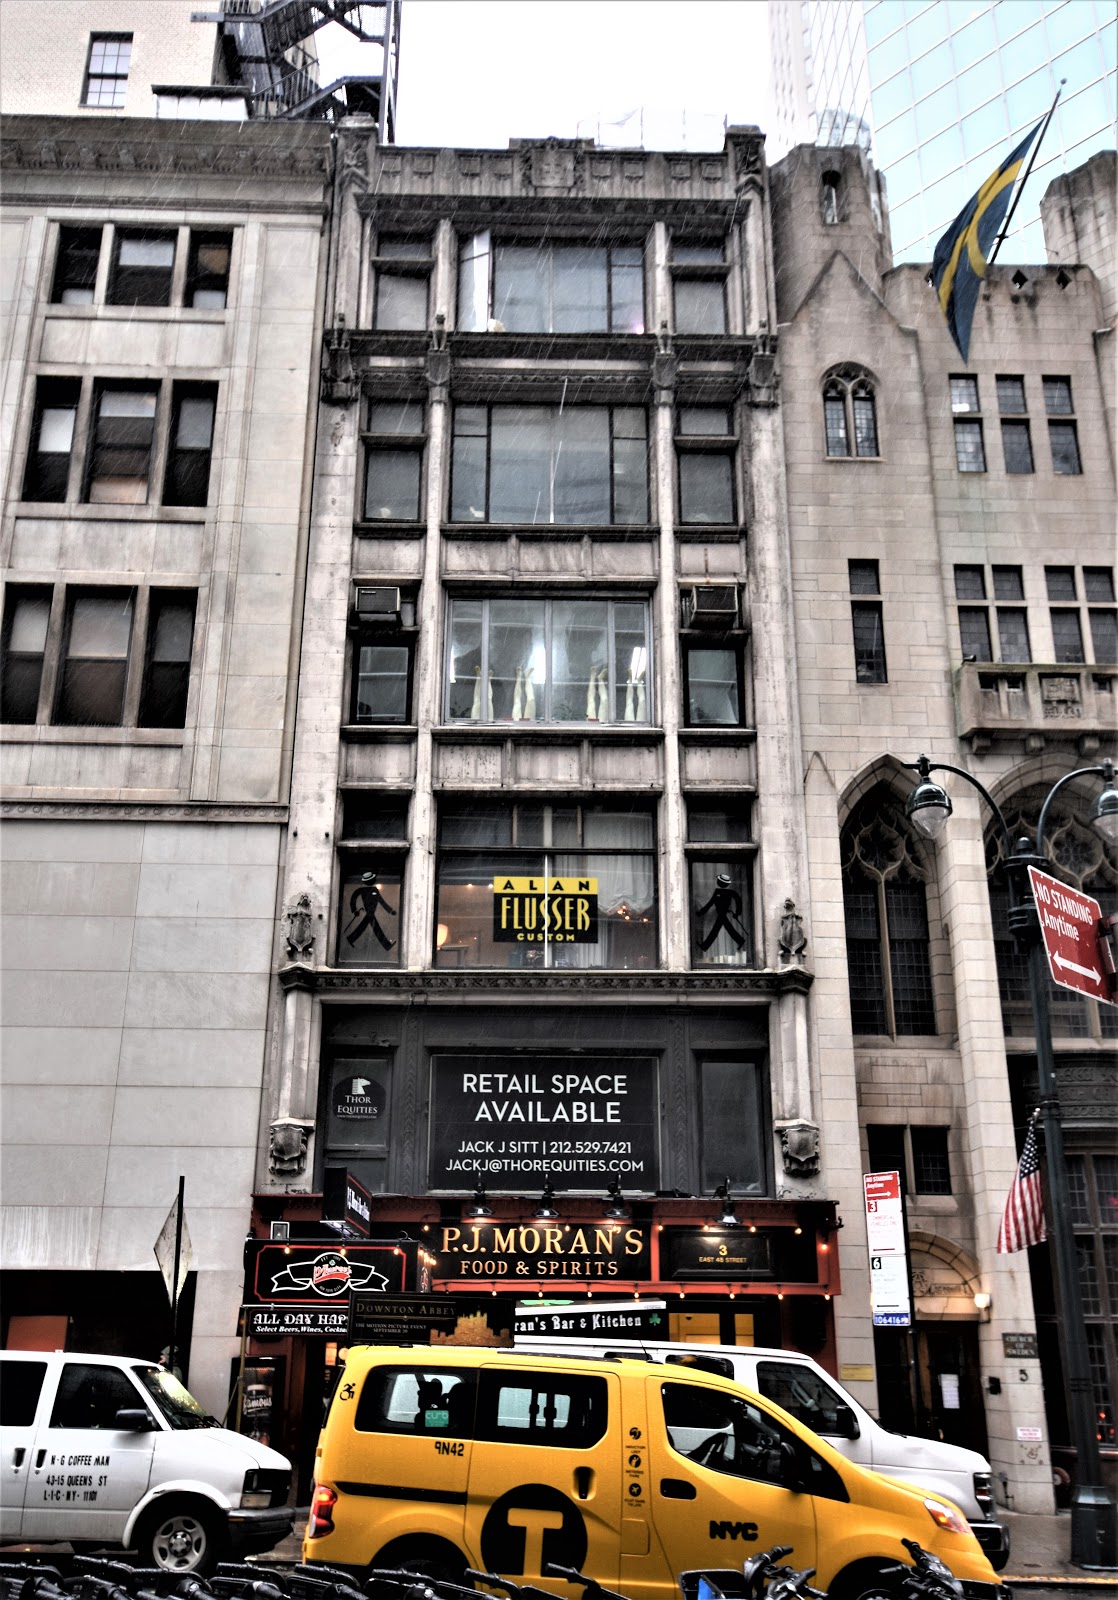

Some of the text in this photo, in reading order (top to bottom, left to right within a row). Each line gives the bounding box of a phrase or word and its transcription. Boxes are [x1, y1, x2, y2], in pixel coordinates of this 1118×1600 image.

[502, 879, 591, 892] ALAN
[1036, 881, 1093, 926] NO STANDING
[501, 896, 591, 932] FLUSSER
[1044, 908, 1080, 942] Anytime
[516, 932, 575, 942] CUSTOM
[463, 1073, 628, 1095] RETAIL SPACE
[345, 1095, 371, 1103] THOR
[337, 1105, 378, 1115] EQUITIES
[474, 1101, 622, 1123] AVAILABLE
[458, 1141, 495, 1154] JACK
[498, 1141, 506, 1154] J
[508, 1141, 539, 1154] SITT
[549, 1141, 632, 1154] 212.529.7421
[445, 1159, 644, 1172] JACKJ@THOREQUITIES.COM
[869, 1201, 877, 1213] 3
[440, 1227, 644, 1255] P.J. MORAN'S
[718, 1244, 728, 1256] 3
[460, 1260, 619, 1276] FOOD & SPIRITS
[873, 1257, 880, 1269] 6
[356, 1303, 456, 1315] DOWNTON ABBEY
[253, 1313, 281, 1325] ALL
[284, 1313, 315, 1325] DAY
[551, 1315, 575, 1330] Bar
[580, 1318, 587, 1329] &
[592, 1313, 642, 1330] Kitchen
[255, 1325, 277, 1333] Select
[1019, 1369, 1029, 1382] 5
[425, 1411, 448, 1420] curb
[434, 1441, 464, 1458] 9N42
[68, 1455, 92, 1466] COFFEE
[93, 1455, 110, 1467] MAN
[46, 1475, 108, 1487] 43-15 QUEENS ST
[709, 1520, 759, 1542] NYC
[507, 1508, 563, 1576] T
